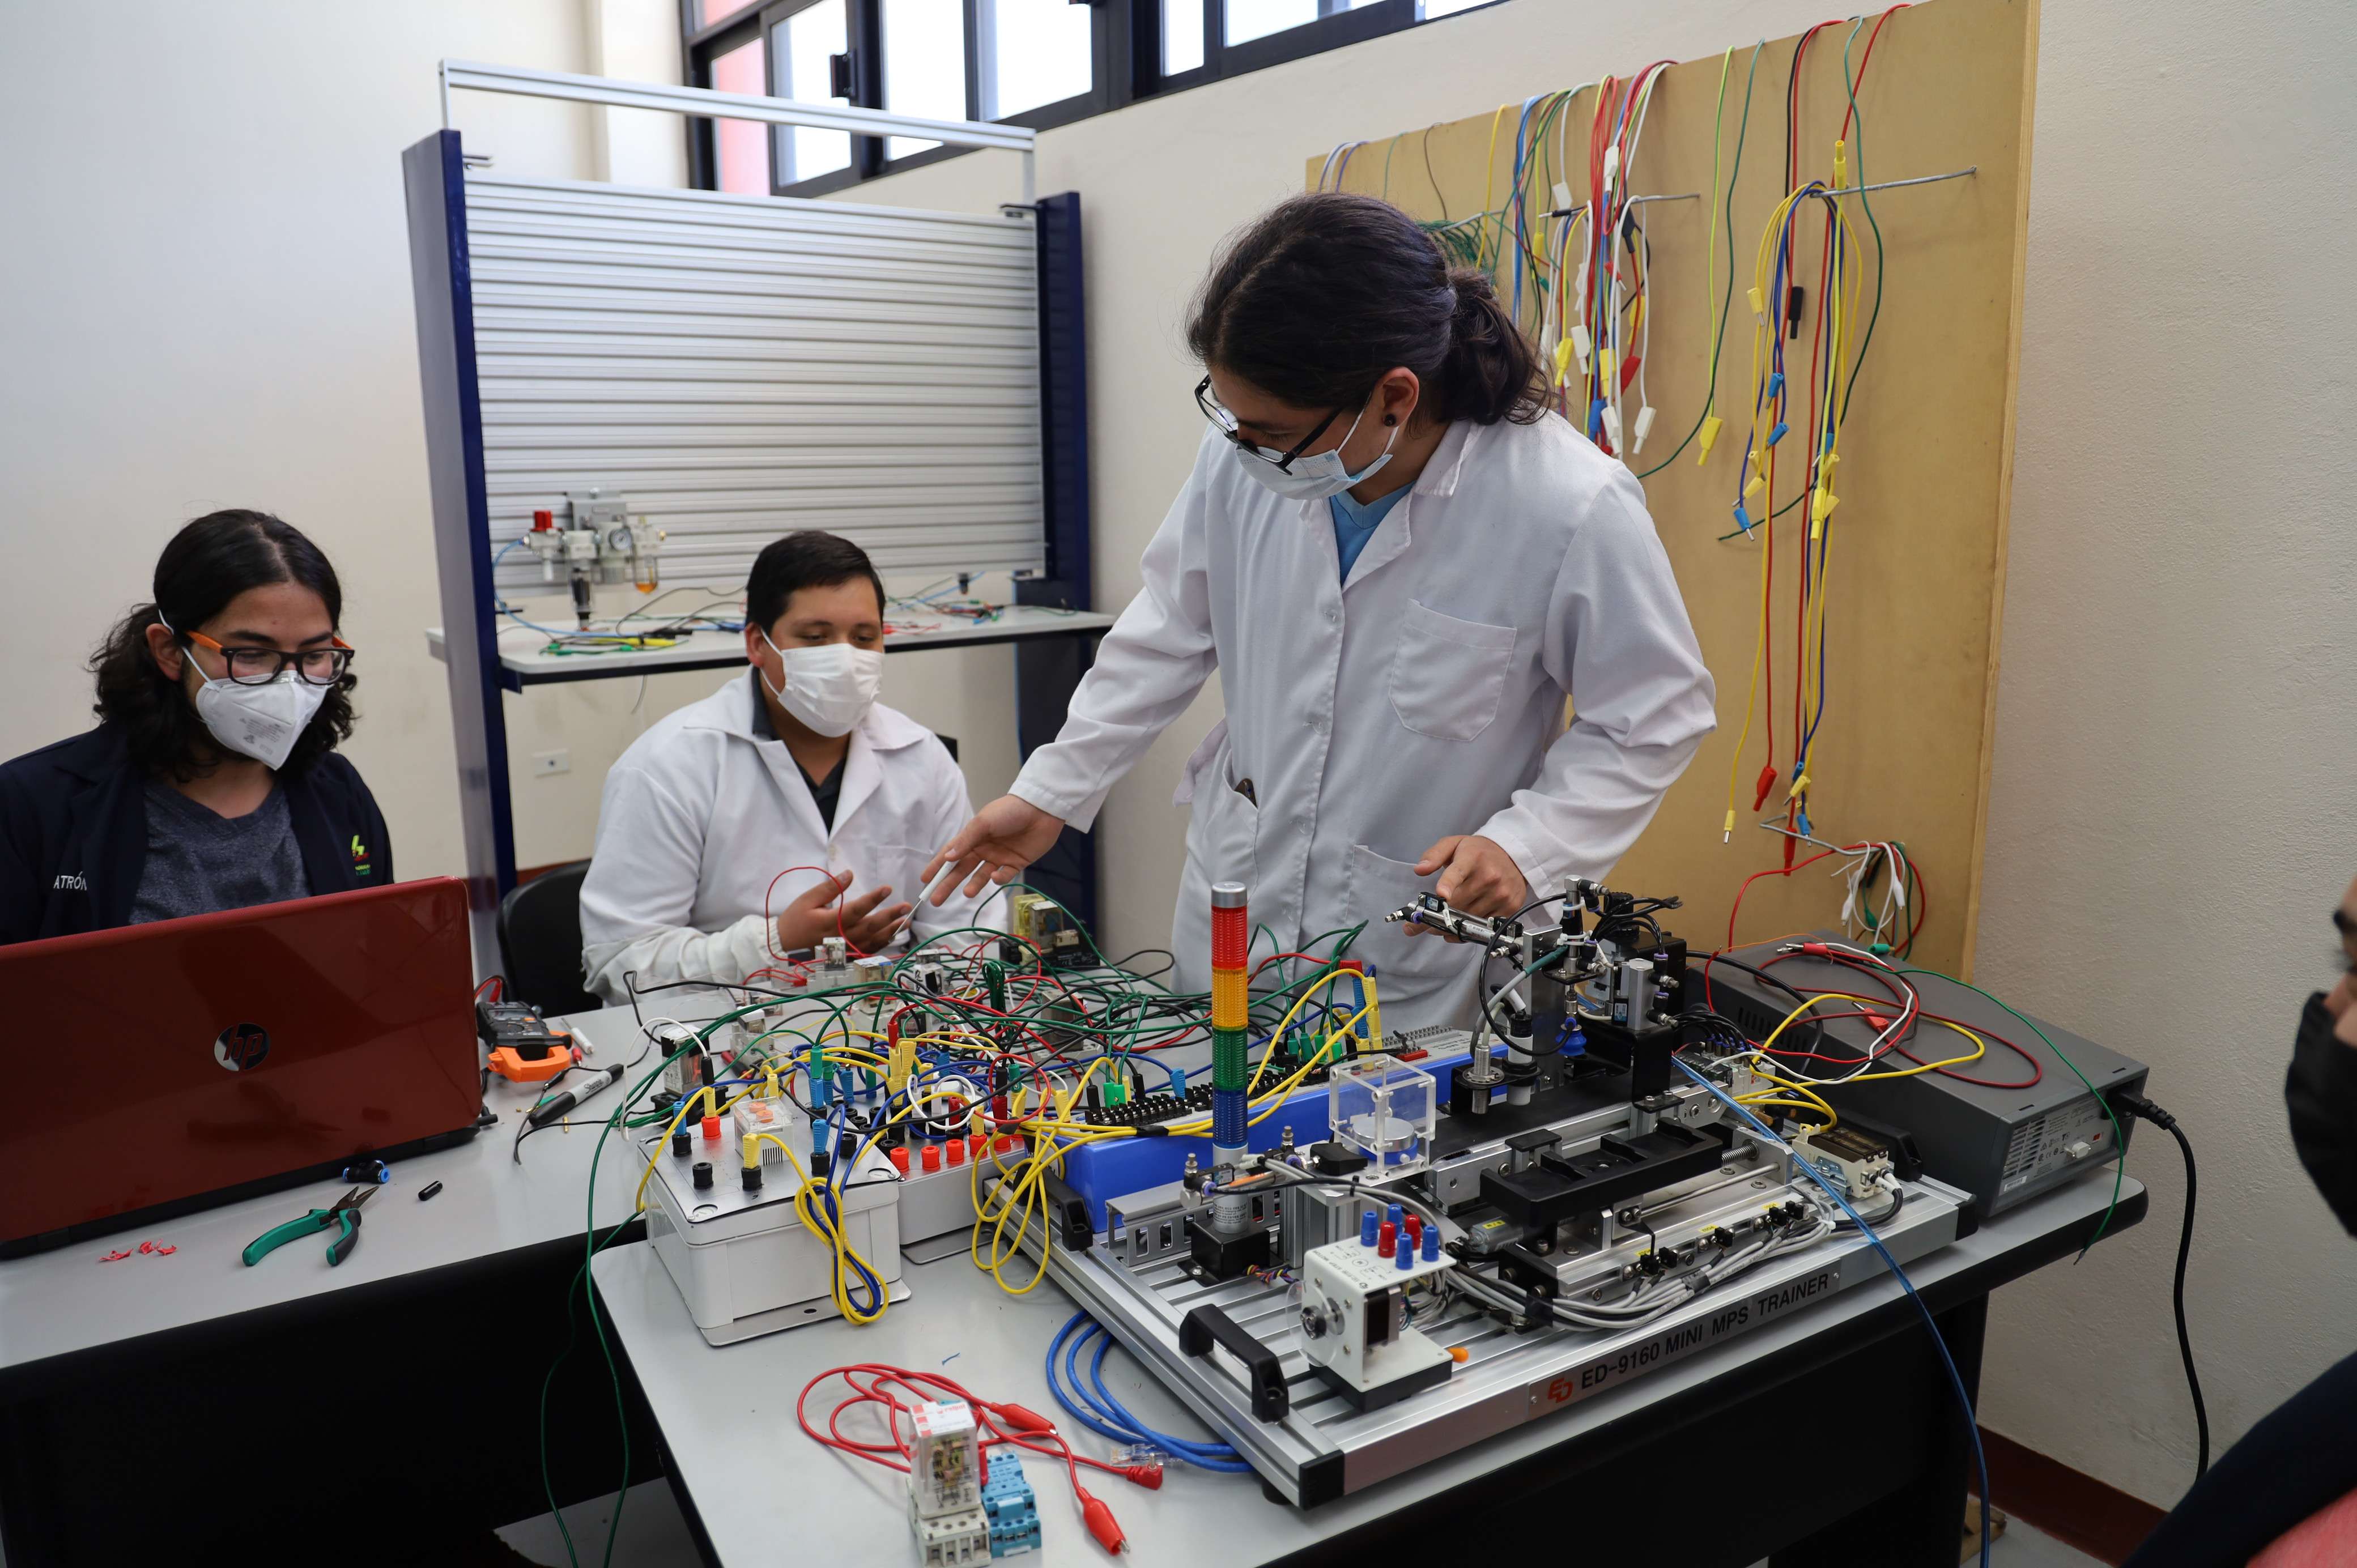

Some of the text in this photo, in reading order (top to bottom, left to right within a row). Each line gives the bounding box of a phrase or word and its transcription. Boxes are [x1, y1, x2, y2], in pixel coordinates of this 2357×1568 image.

[223, 1023, 264, 1072] hp
[1581, 1341, 1660, 1390] ED-9160
[1666, 1324, 1703, 1355] MINI
[1712, 1306, 1749, 1336] MPS
[1758, 1273, 1828, 1316] TRAINER
